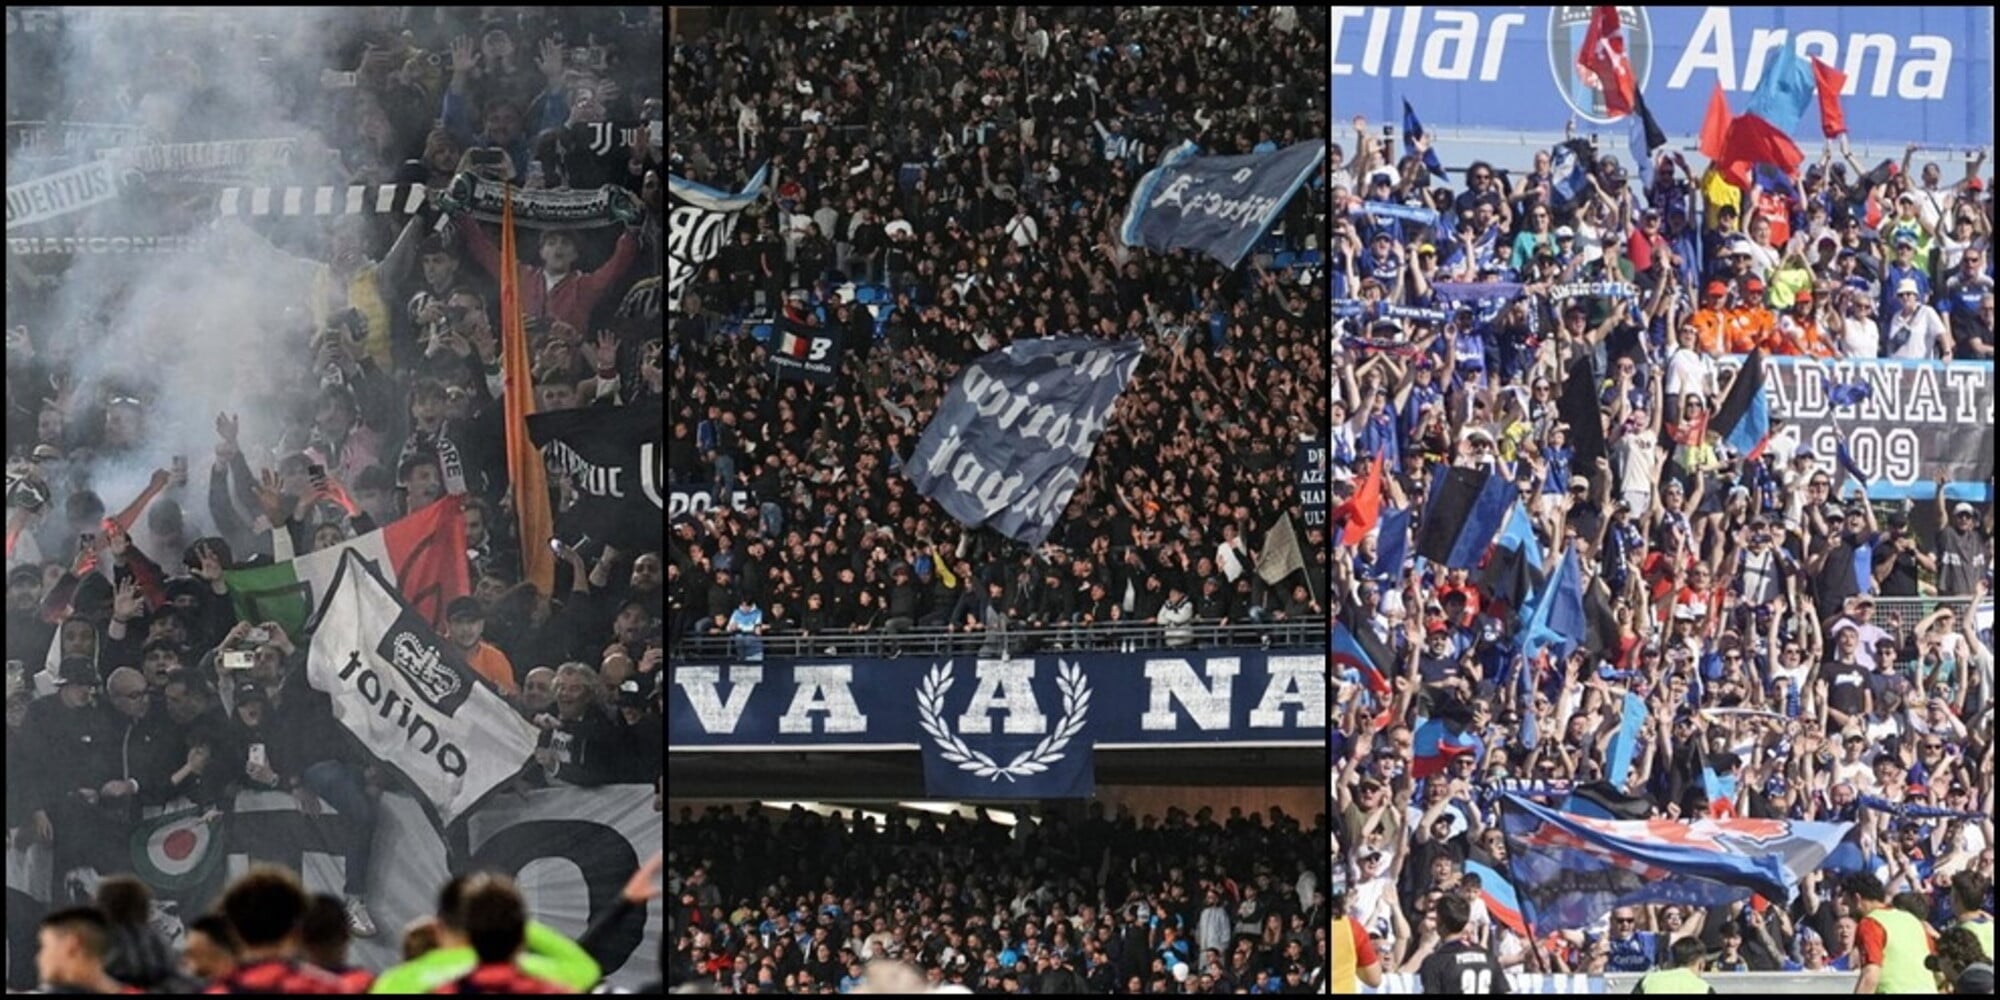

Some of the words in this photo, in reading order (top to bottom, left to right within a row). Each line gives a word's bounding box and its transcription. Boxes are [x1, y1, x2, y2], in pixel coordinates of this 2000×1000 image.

[1716, 356, 1994, 423] ADINAT
[338, 651, 467, 778] torino
[958, 658, 1047, 734] A
[1141, 654, 1326, 731] NA
